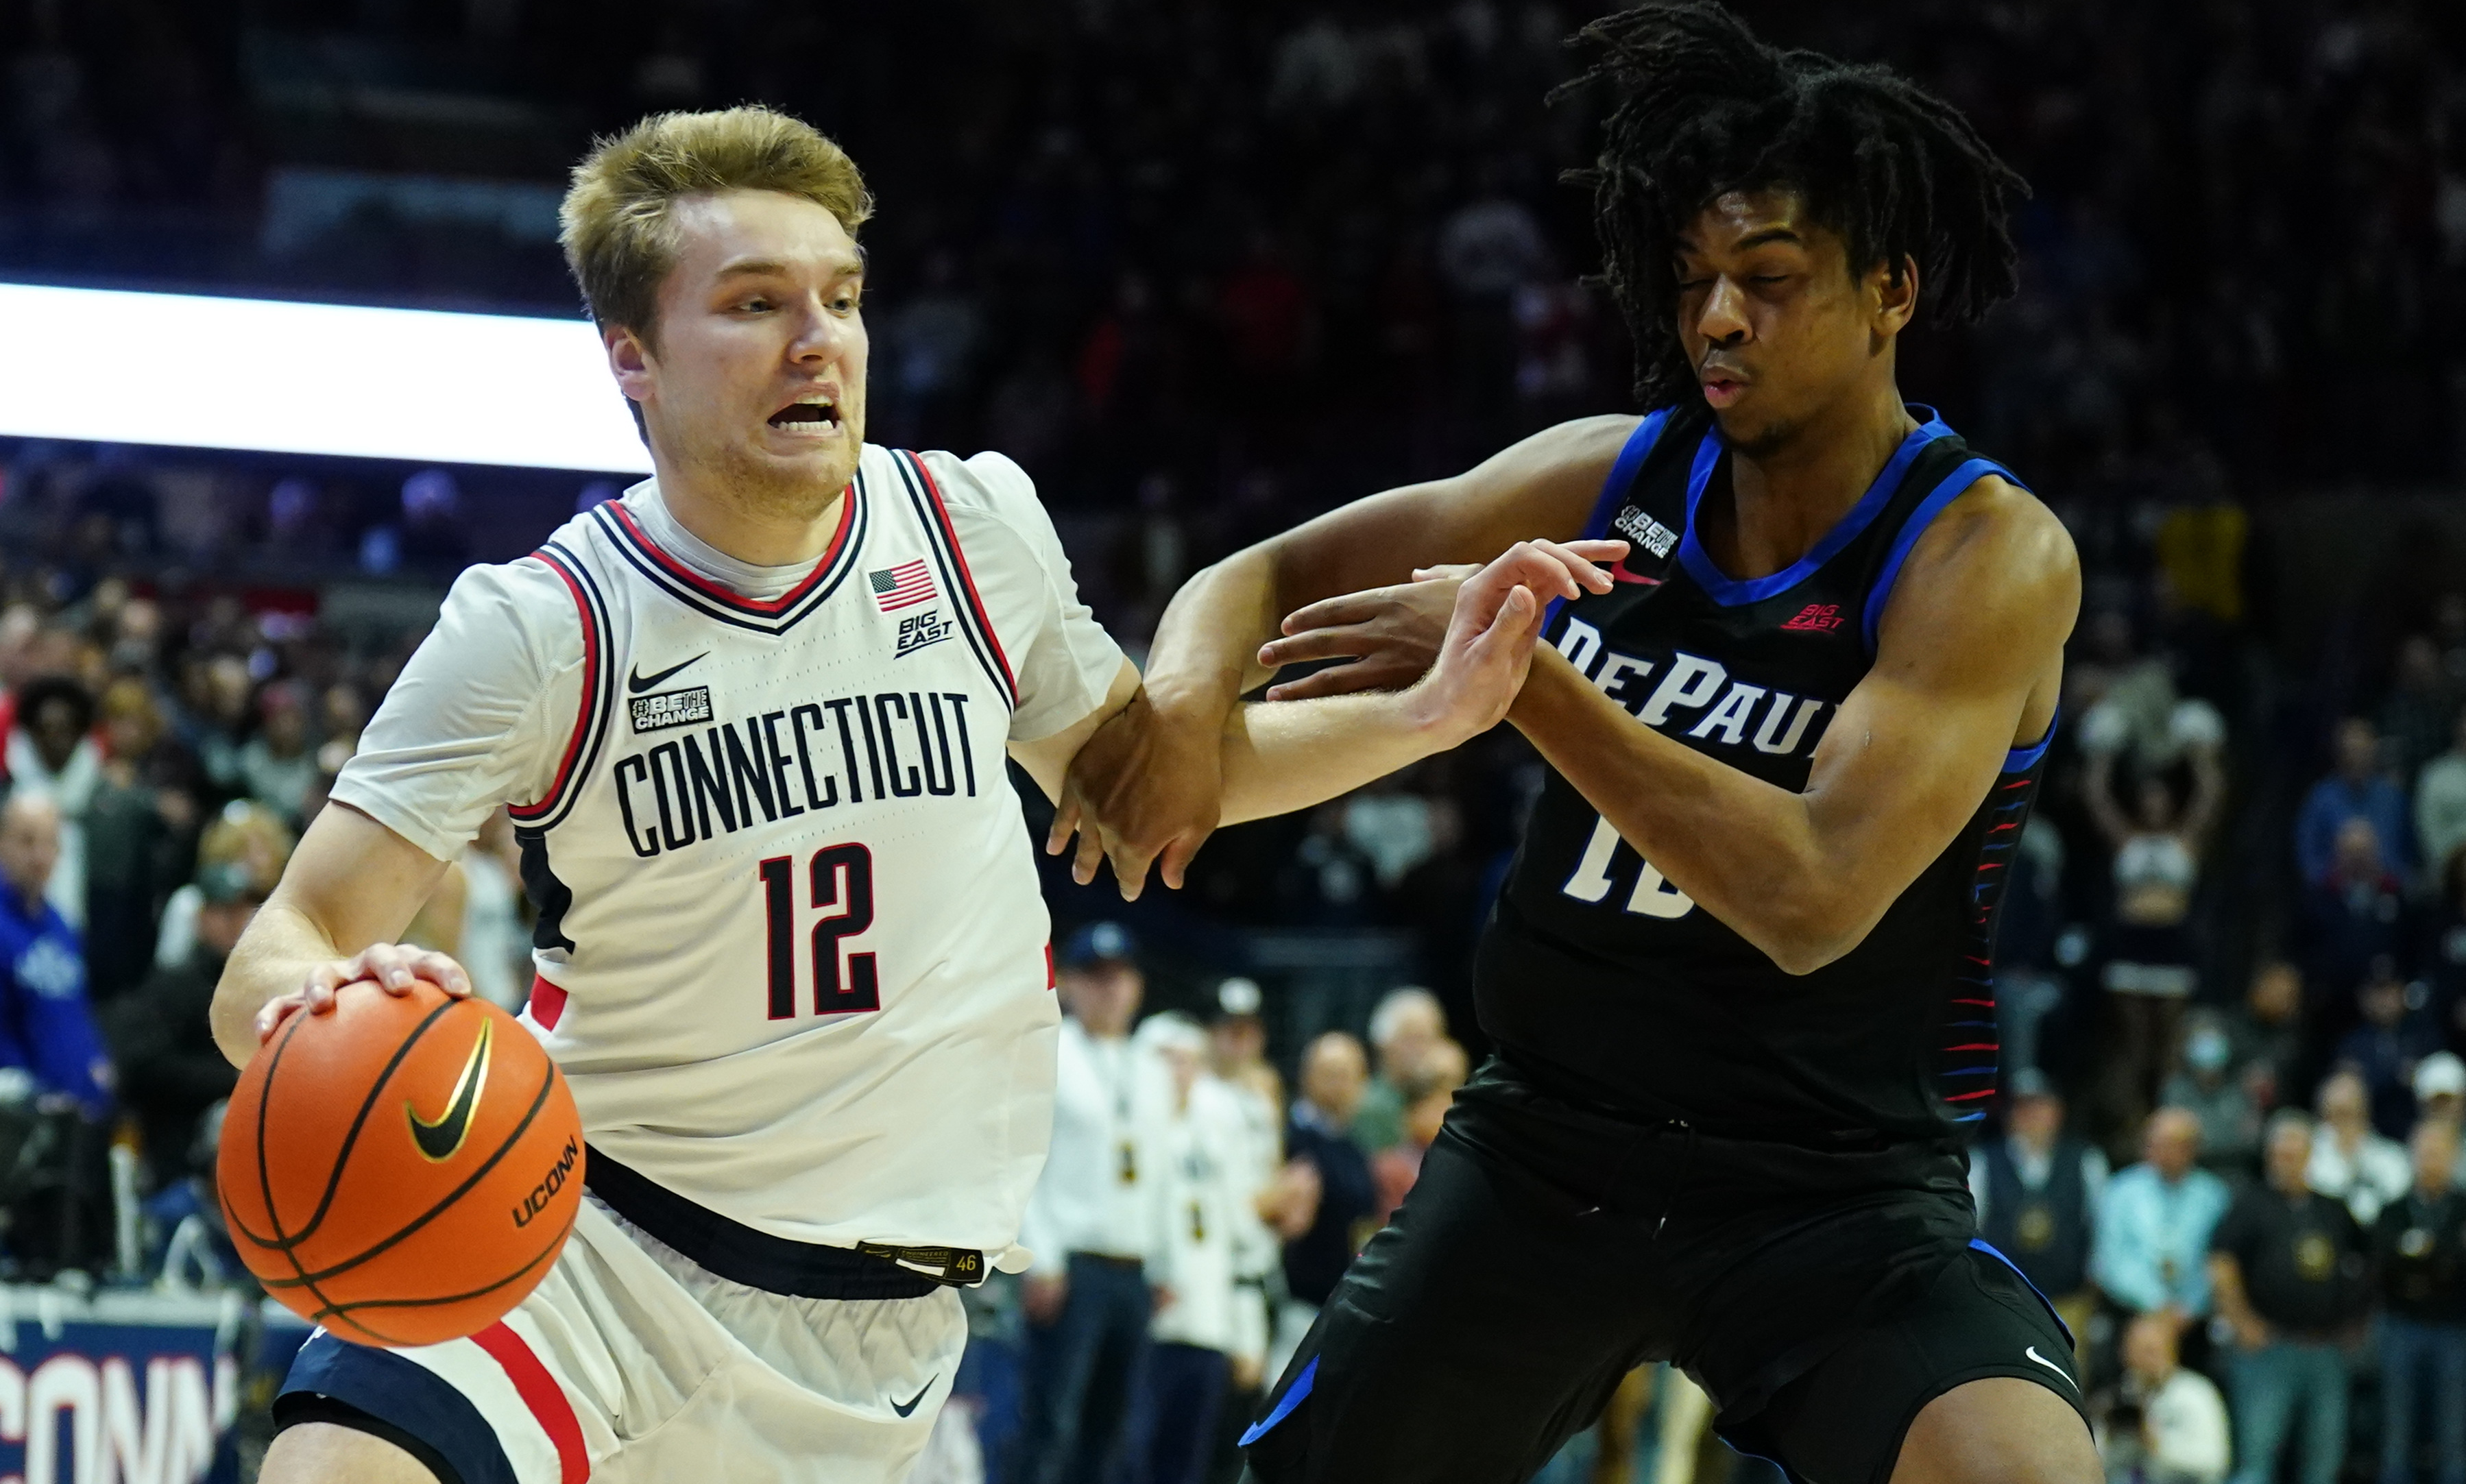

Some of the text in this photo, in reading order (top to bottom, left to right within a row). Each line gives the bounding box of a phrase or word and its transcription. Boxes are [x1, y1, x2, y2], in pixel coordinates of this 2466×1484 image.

[1615, 517, 1669, 559] CHANGE
[899, 609, 938, 635] BIG
[1787, 616, 1845, 629] EAST
[1799, 604, 1840, 616] BIG
[897, 620, 953, 650] EAST
[1556, 616, 1842, 759] DEPAU
[635, 705, 710, 730] CHANGE
[614, 692, 976, 857] CONNECTICUT
[759, 842, 880, 1021] 12
[512, 1134, 578, 1228] UCONN
[956, 1255, 977, 1271] 46
